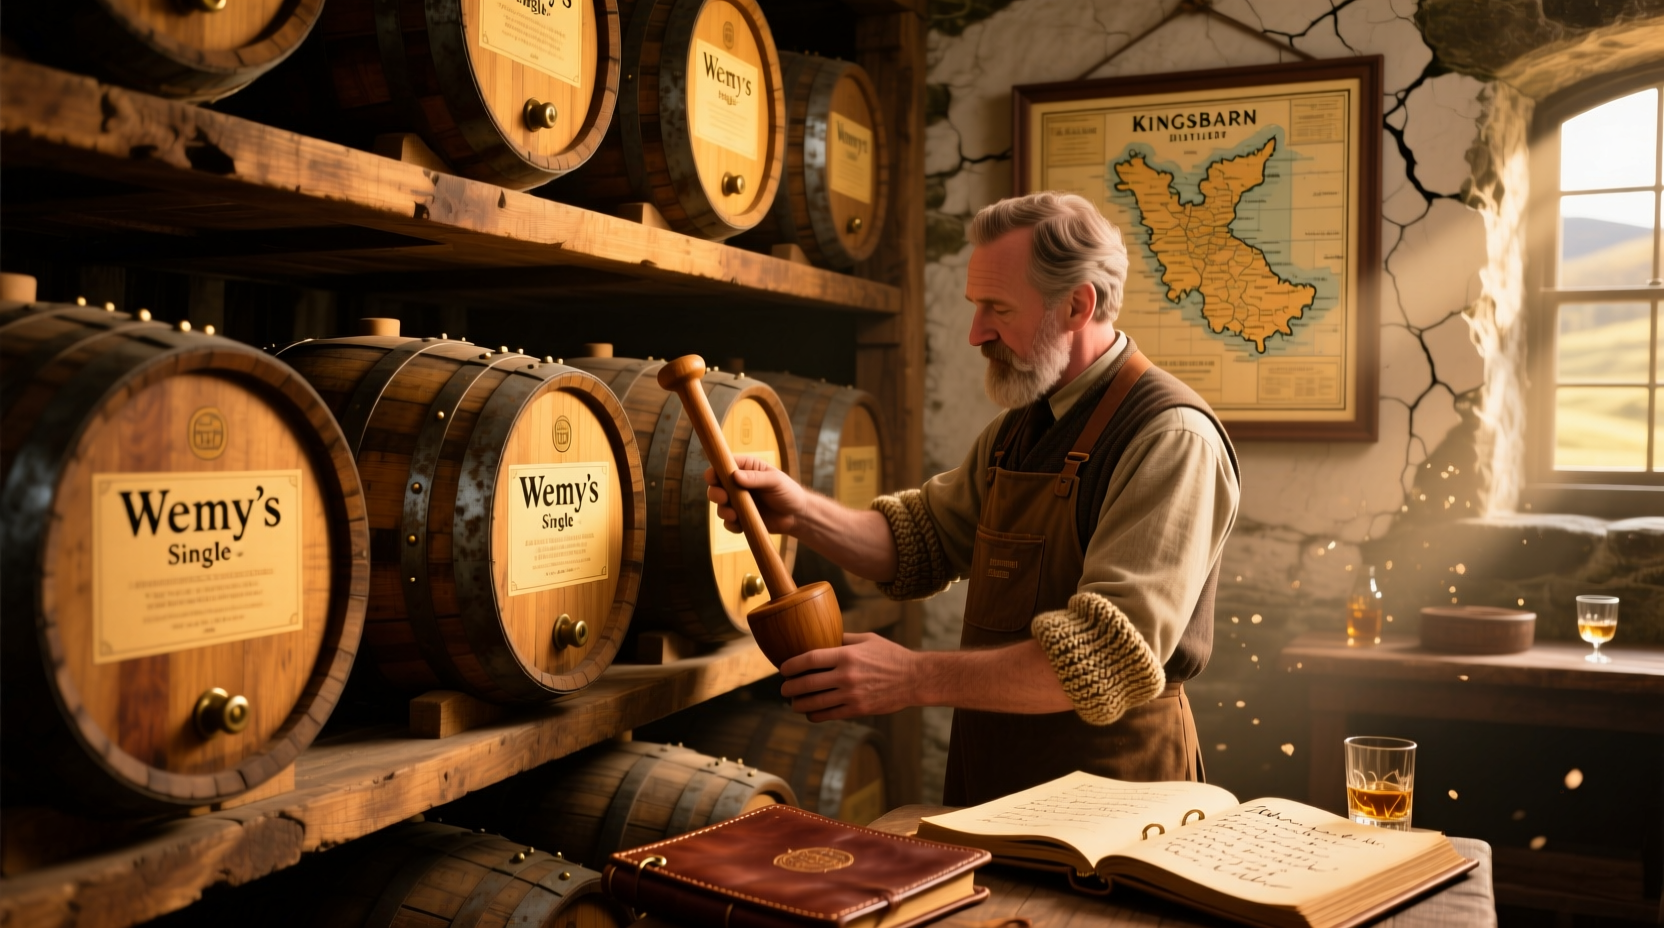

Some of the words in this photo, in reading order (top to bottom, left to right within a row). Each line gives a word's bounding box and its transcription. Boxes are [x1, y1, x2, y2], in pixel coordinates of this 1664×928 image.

[1132, 109, 1257, 132] KINGSBARN
[519, 473, 599, 513] Wemy's
[118, 485, 282, 541] Wemy's
[168, 541, 232, 568] Single
